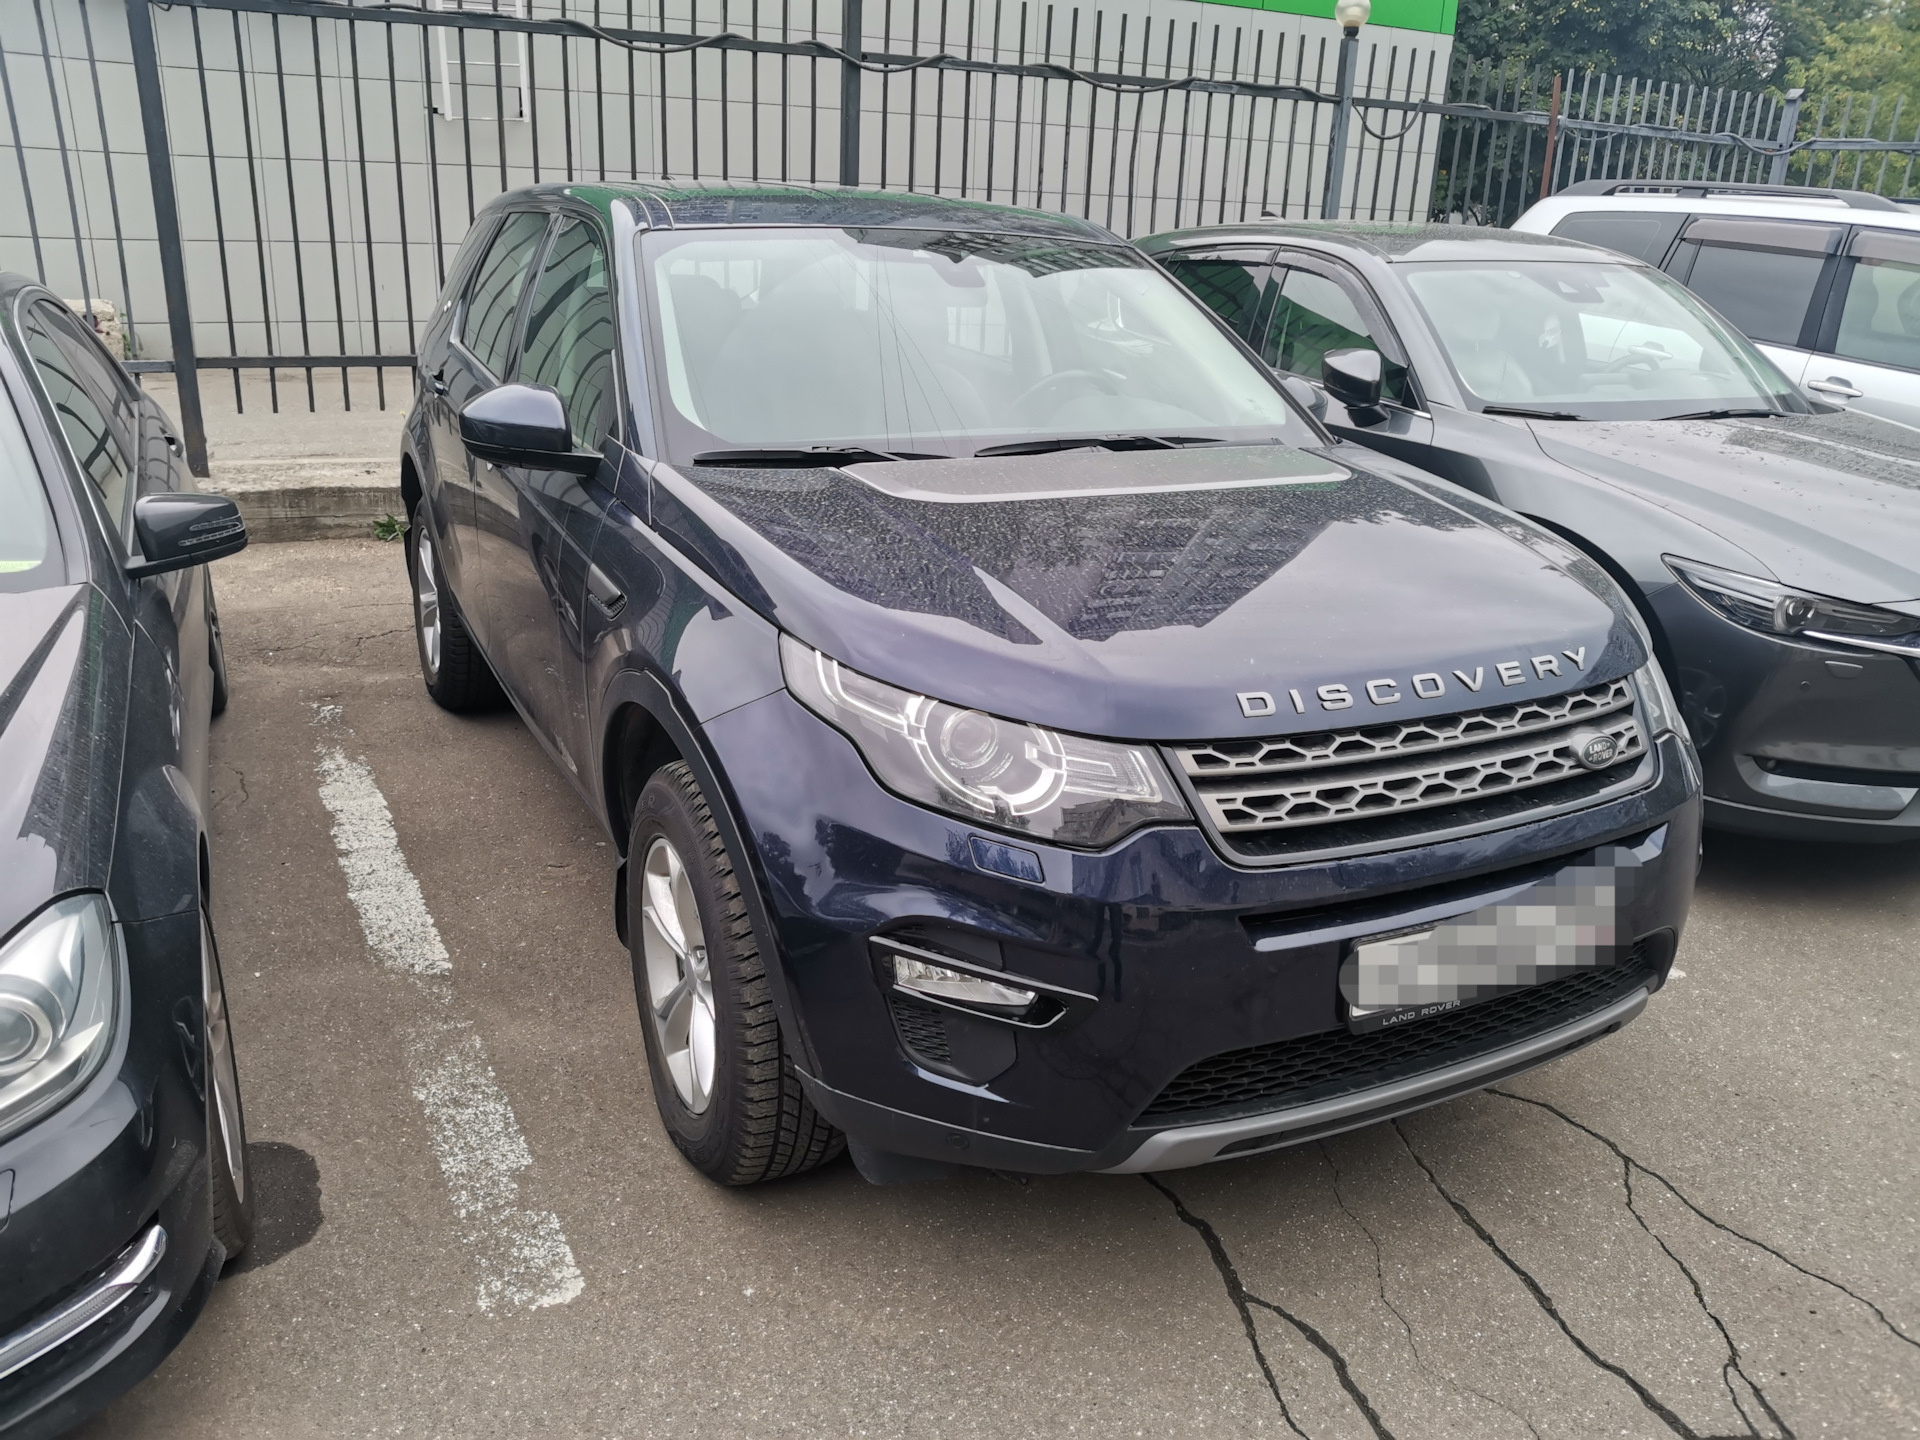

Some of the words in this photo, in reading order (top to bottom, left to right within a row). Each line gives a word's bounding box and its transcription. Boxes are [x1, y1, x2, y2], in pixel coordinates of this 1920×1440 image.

[1236, 647, 1586, 718] DISCOVERY
[1589, 741, 1607, 754] LAND
[1592, 748, 1613, 762] ROVER
[1382, 1011, 1416, 1026] LAND
[1421, 1000, 1461, 1016] ROVER
